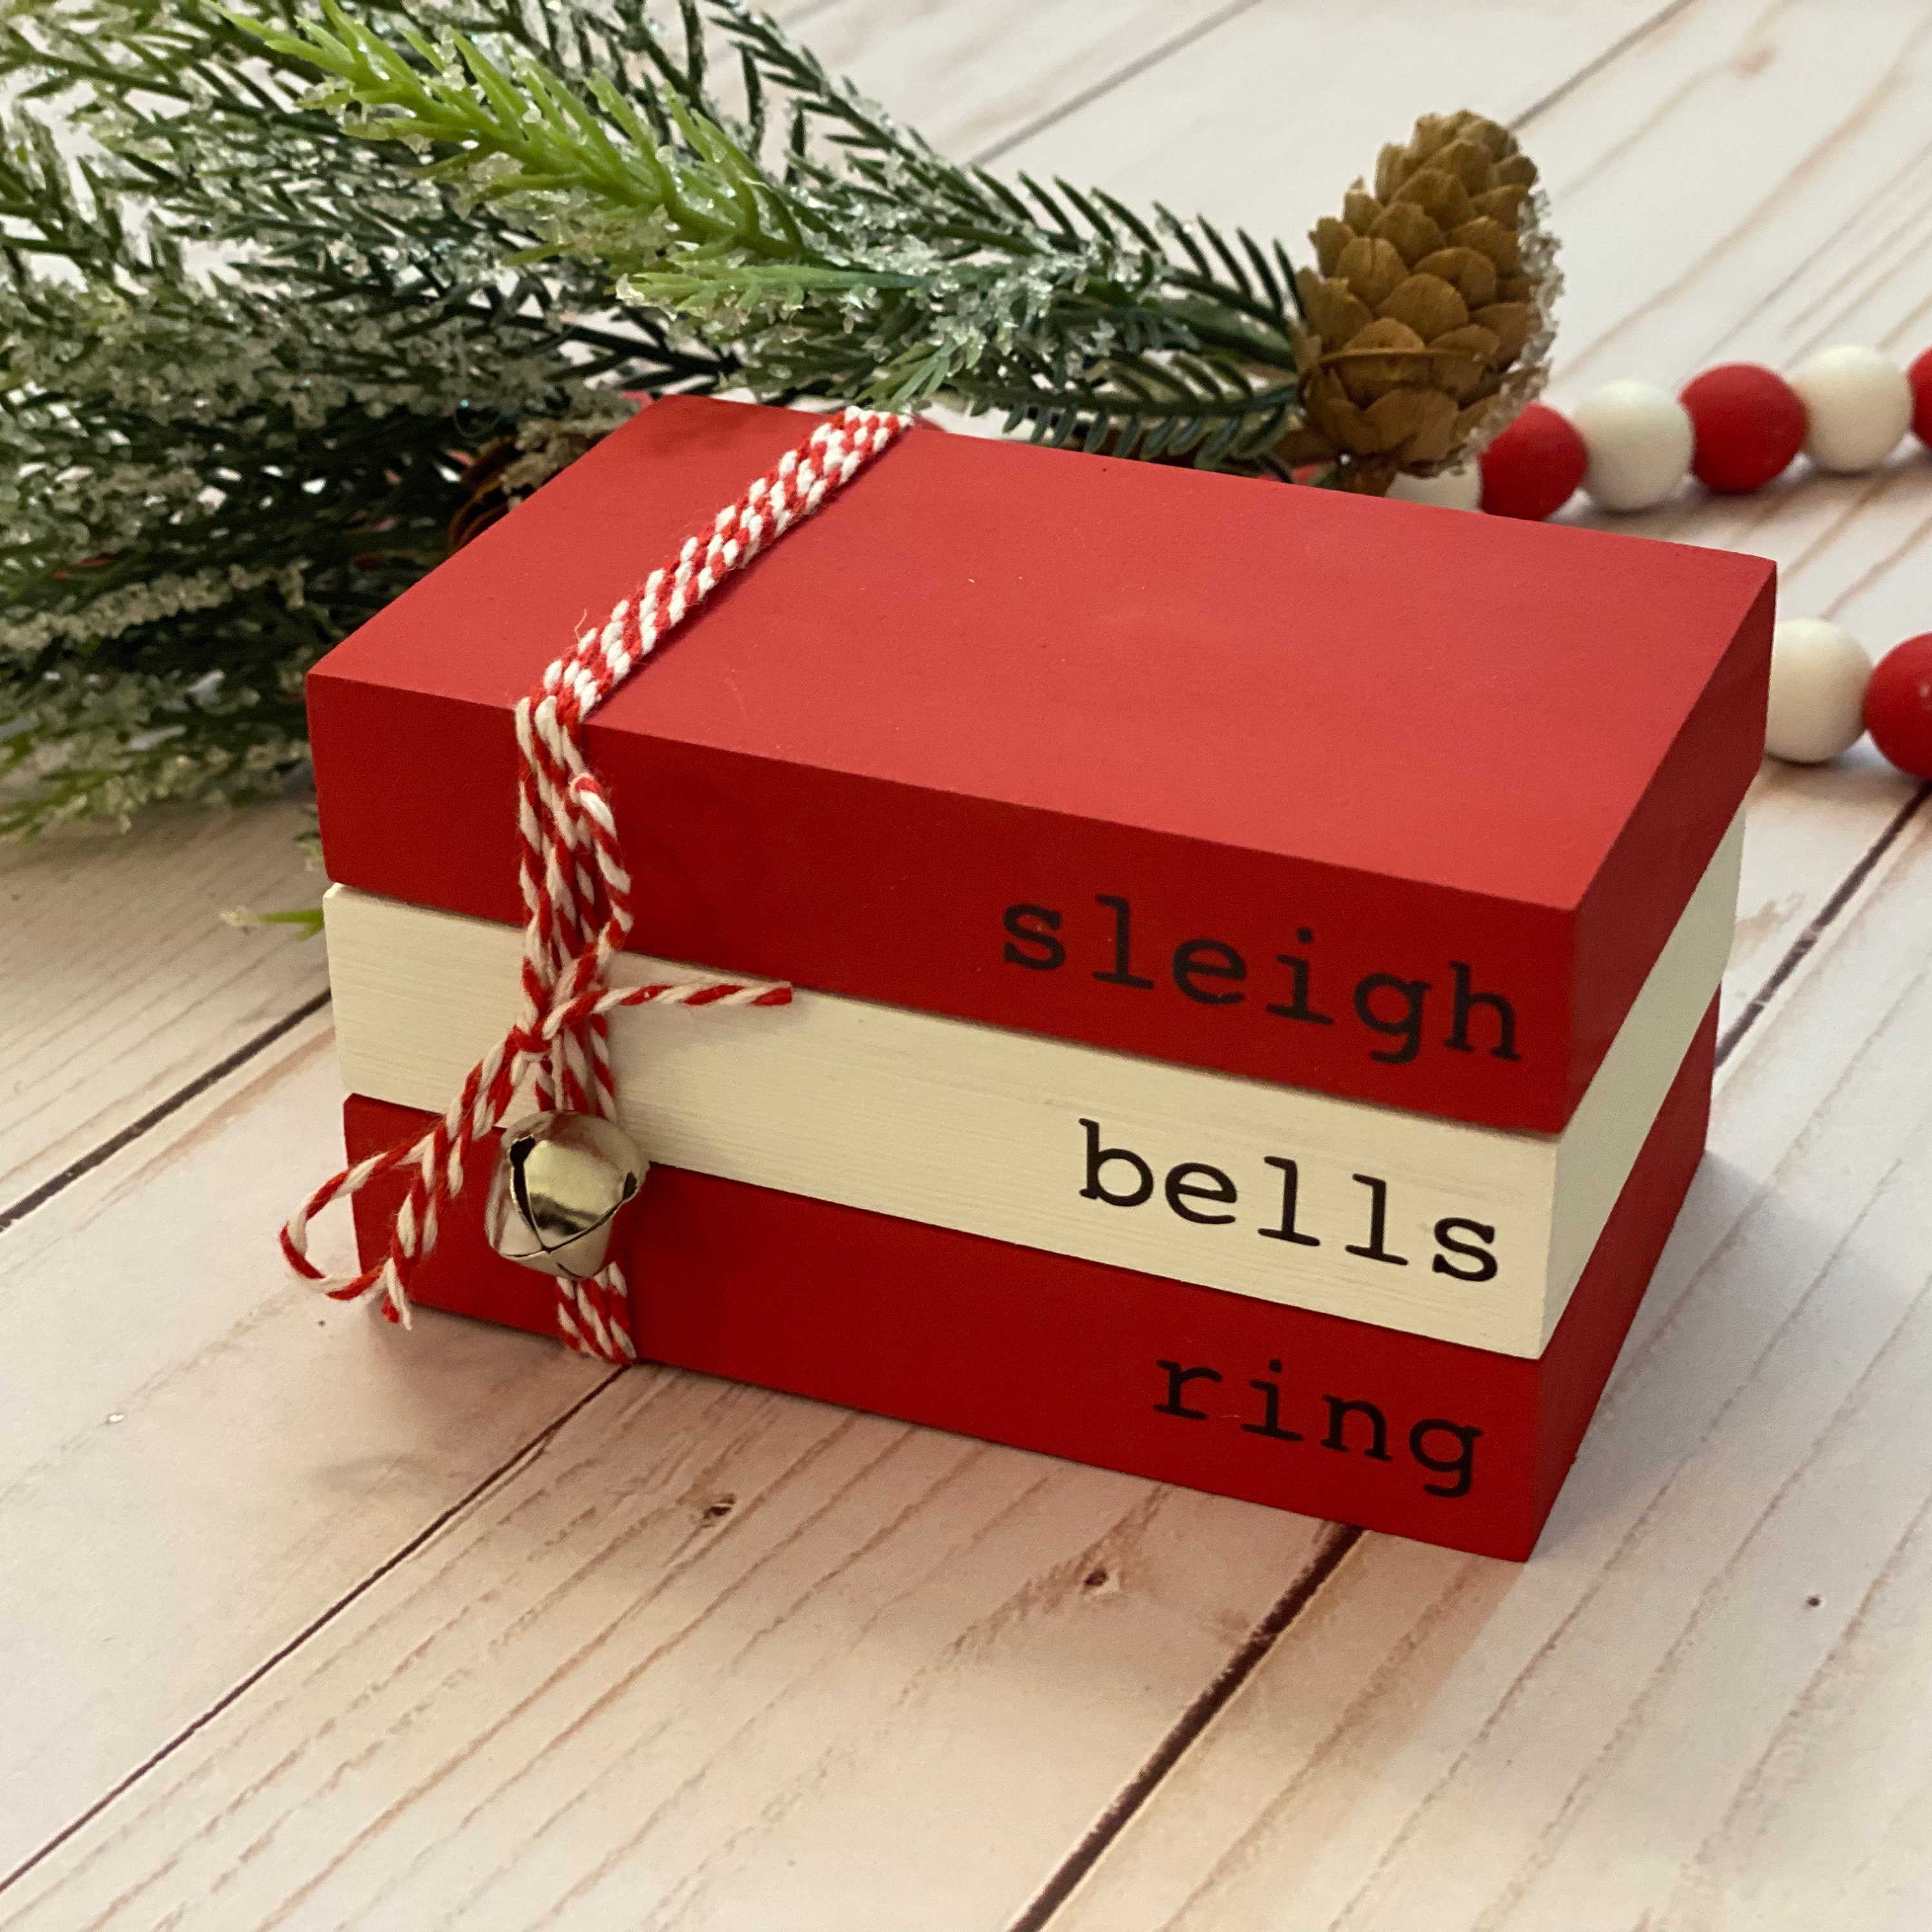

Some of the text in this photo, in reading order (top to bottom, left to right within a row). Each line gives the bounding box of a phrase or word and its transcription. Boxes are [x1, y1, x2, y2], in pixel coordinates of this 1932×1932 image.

[1002, 893, 1522, 1066] sleigh
[1079, 1117, 1498, 1283] bells
[1152, 1358, 1484, 1500] ring
